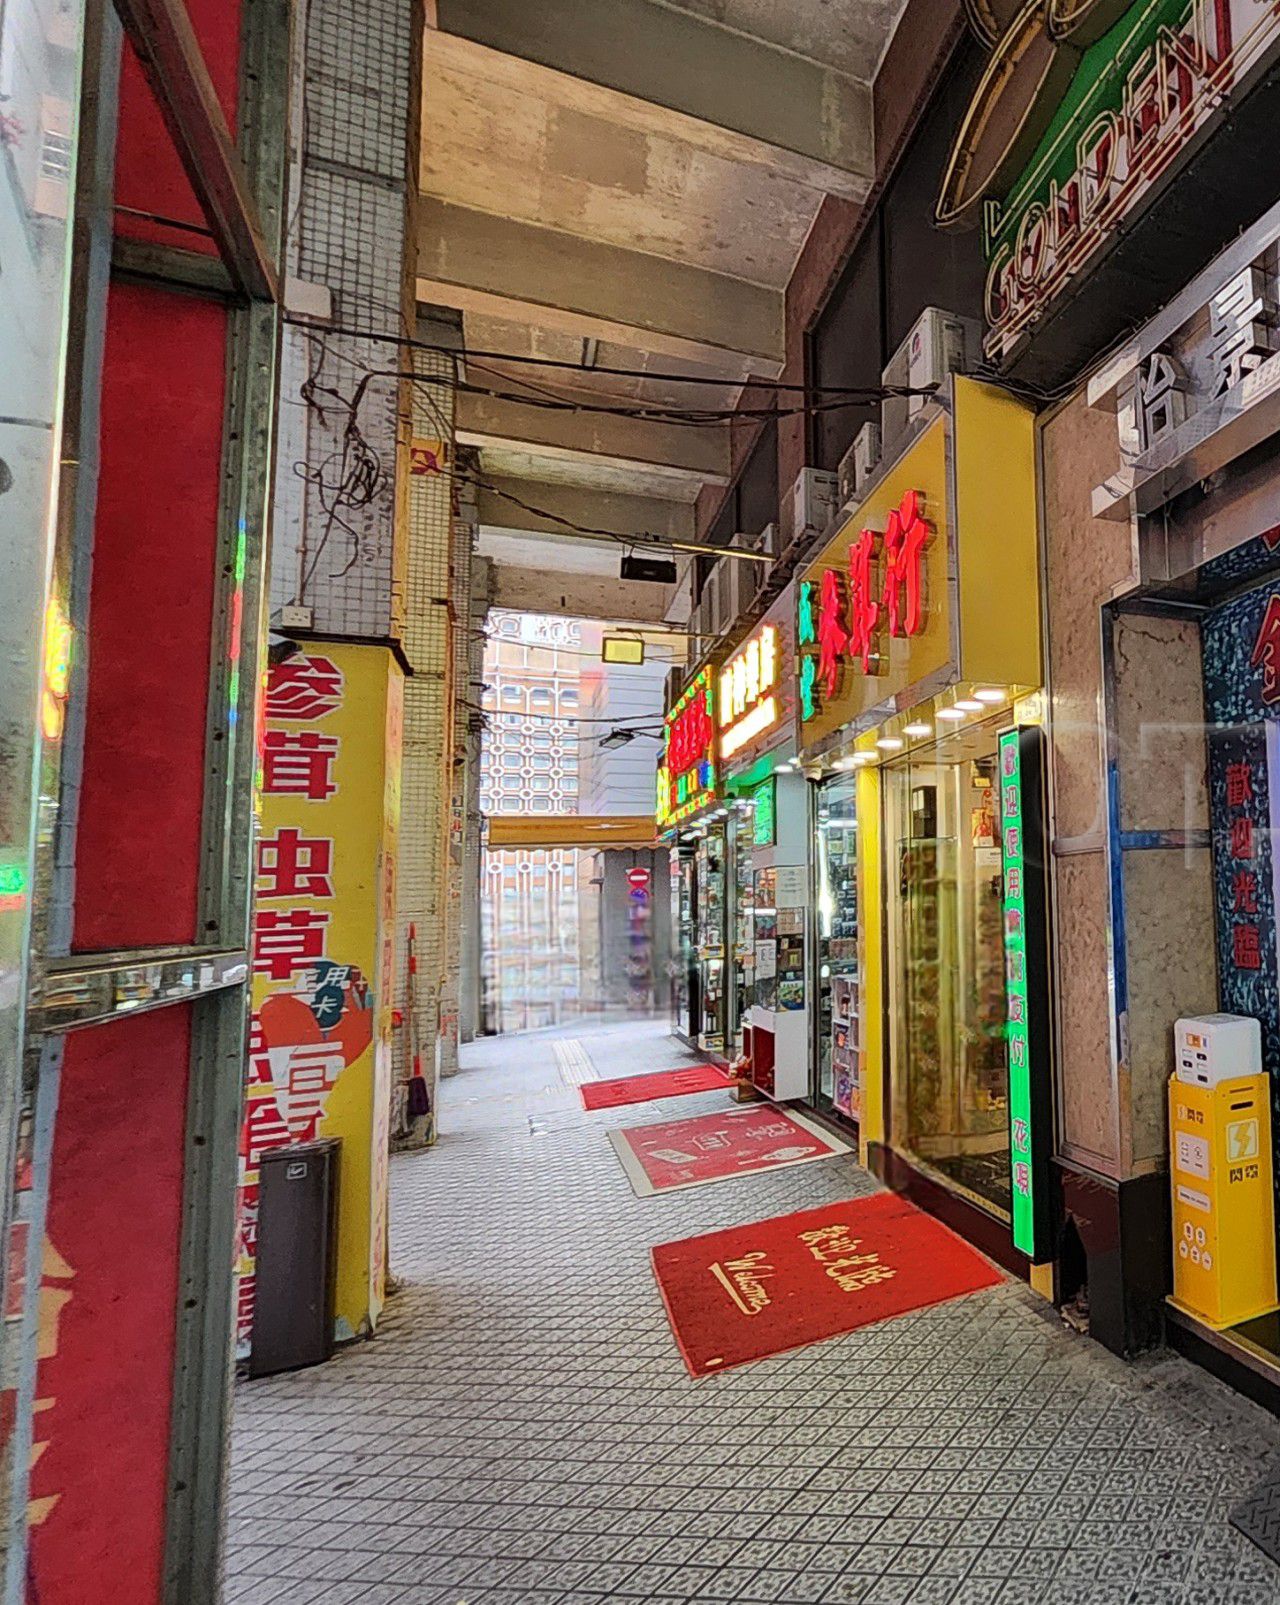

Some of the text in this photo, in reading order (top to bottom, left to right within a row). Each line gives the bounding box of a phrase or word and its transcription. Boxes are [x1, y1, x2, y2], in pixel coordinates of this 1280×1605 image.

[1225, 763, 1261, 970] 歡迎光臨
[709, 1251, 777, 1315] Welcome
